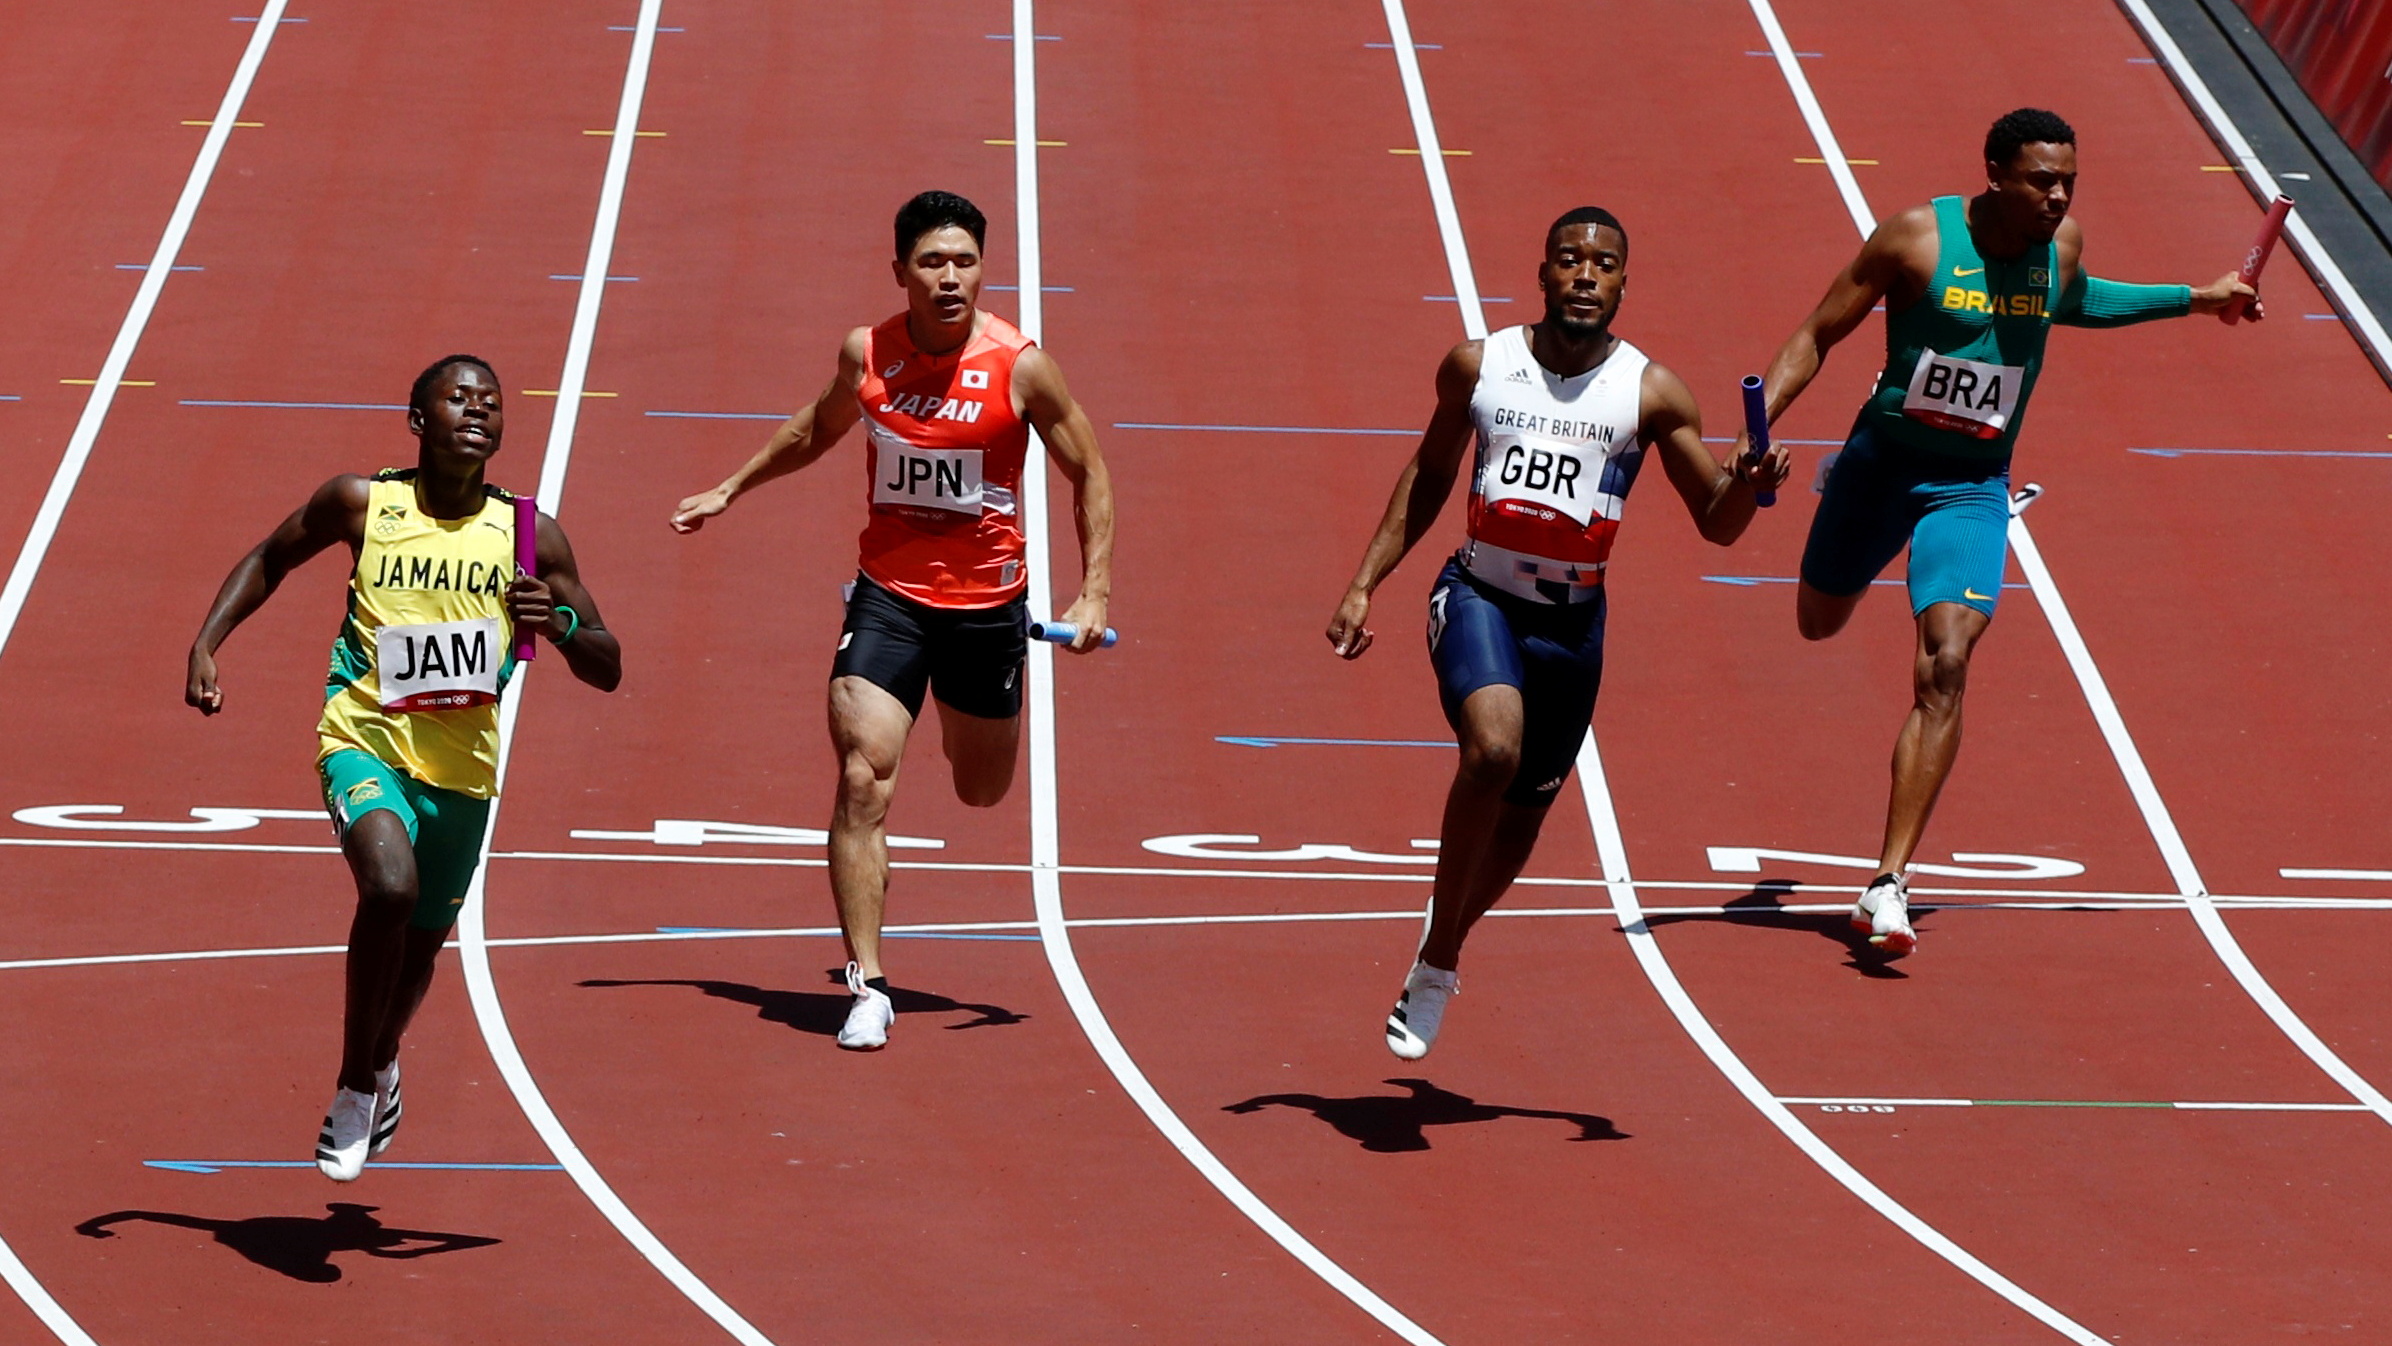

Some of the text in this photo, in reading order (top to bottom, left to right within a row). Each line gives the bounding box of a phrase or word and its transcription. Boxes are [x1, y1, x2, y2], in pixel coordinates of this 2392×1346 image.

[1942, 286, 2050, 318] BRASIL
[1922, 363, 2002, 412] BRA
[879, 392, 983, 423] JAPAN
[1495, 408, 1615, 444] GREAT BRITAIN
[887, 455, 962, 498] JPN
[1500, 445, 1582, 499] GBR
[373, 555, 500, 597] JAMAICA
[394, 630, 487, 681] JAM
[569, 820, 945, 848] 4
[1706, 847, 2086, 879] 2
